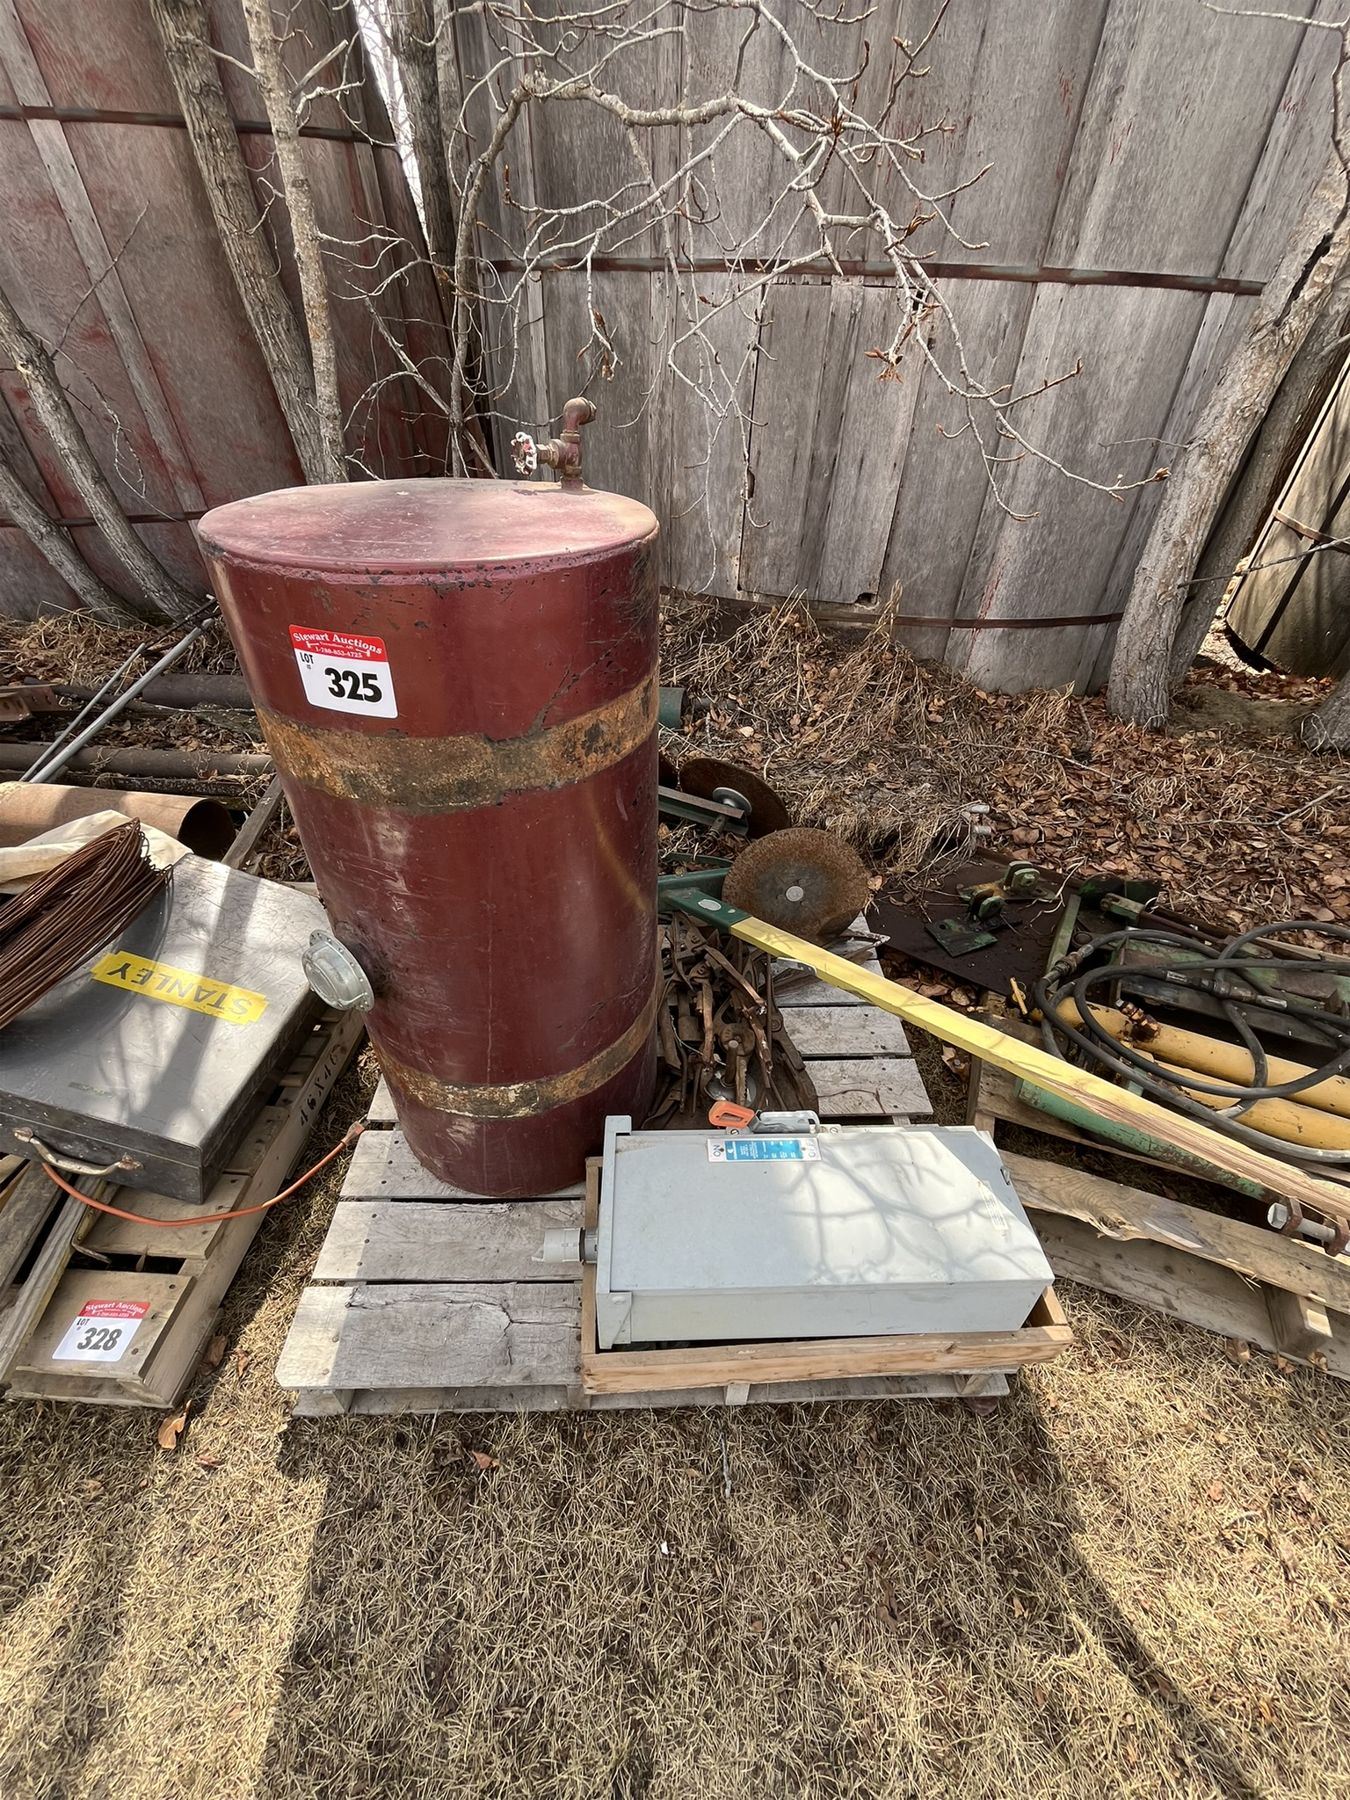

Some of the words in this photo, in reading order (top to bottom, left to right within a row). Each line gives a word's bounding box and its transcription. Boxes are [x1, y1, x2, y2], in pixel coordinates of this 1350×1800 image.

[293, 632, 330, 642] Stewart
[332, 634, 382, 655] Auctions
[300, 652, 314, 664] LOT
[324, 667, 382, 703] 325
[107, 962, 253, 1015] STANLEY
[115, 1302, 146, 1314] Auctions
[76, 1318, 90, 1326] LOT
[76, 1327, 123, 1351] 328
